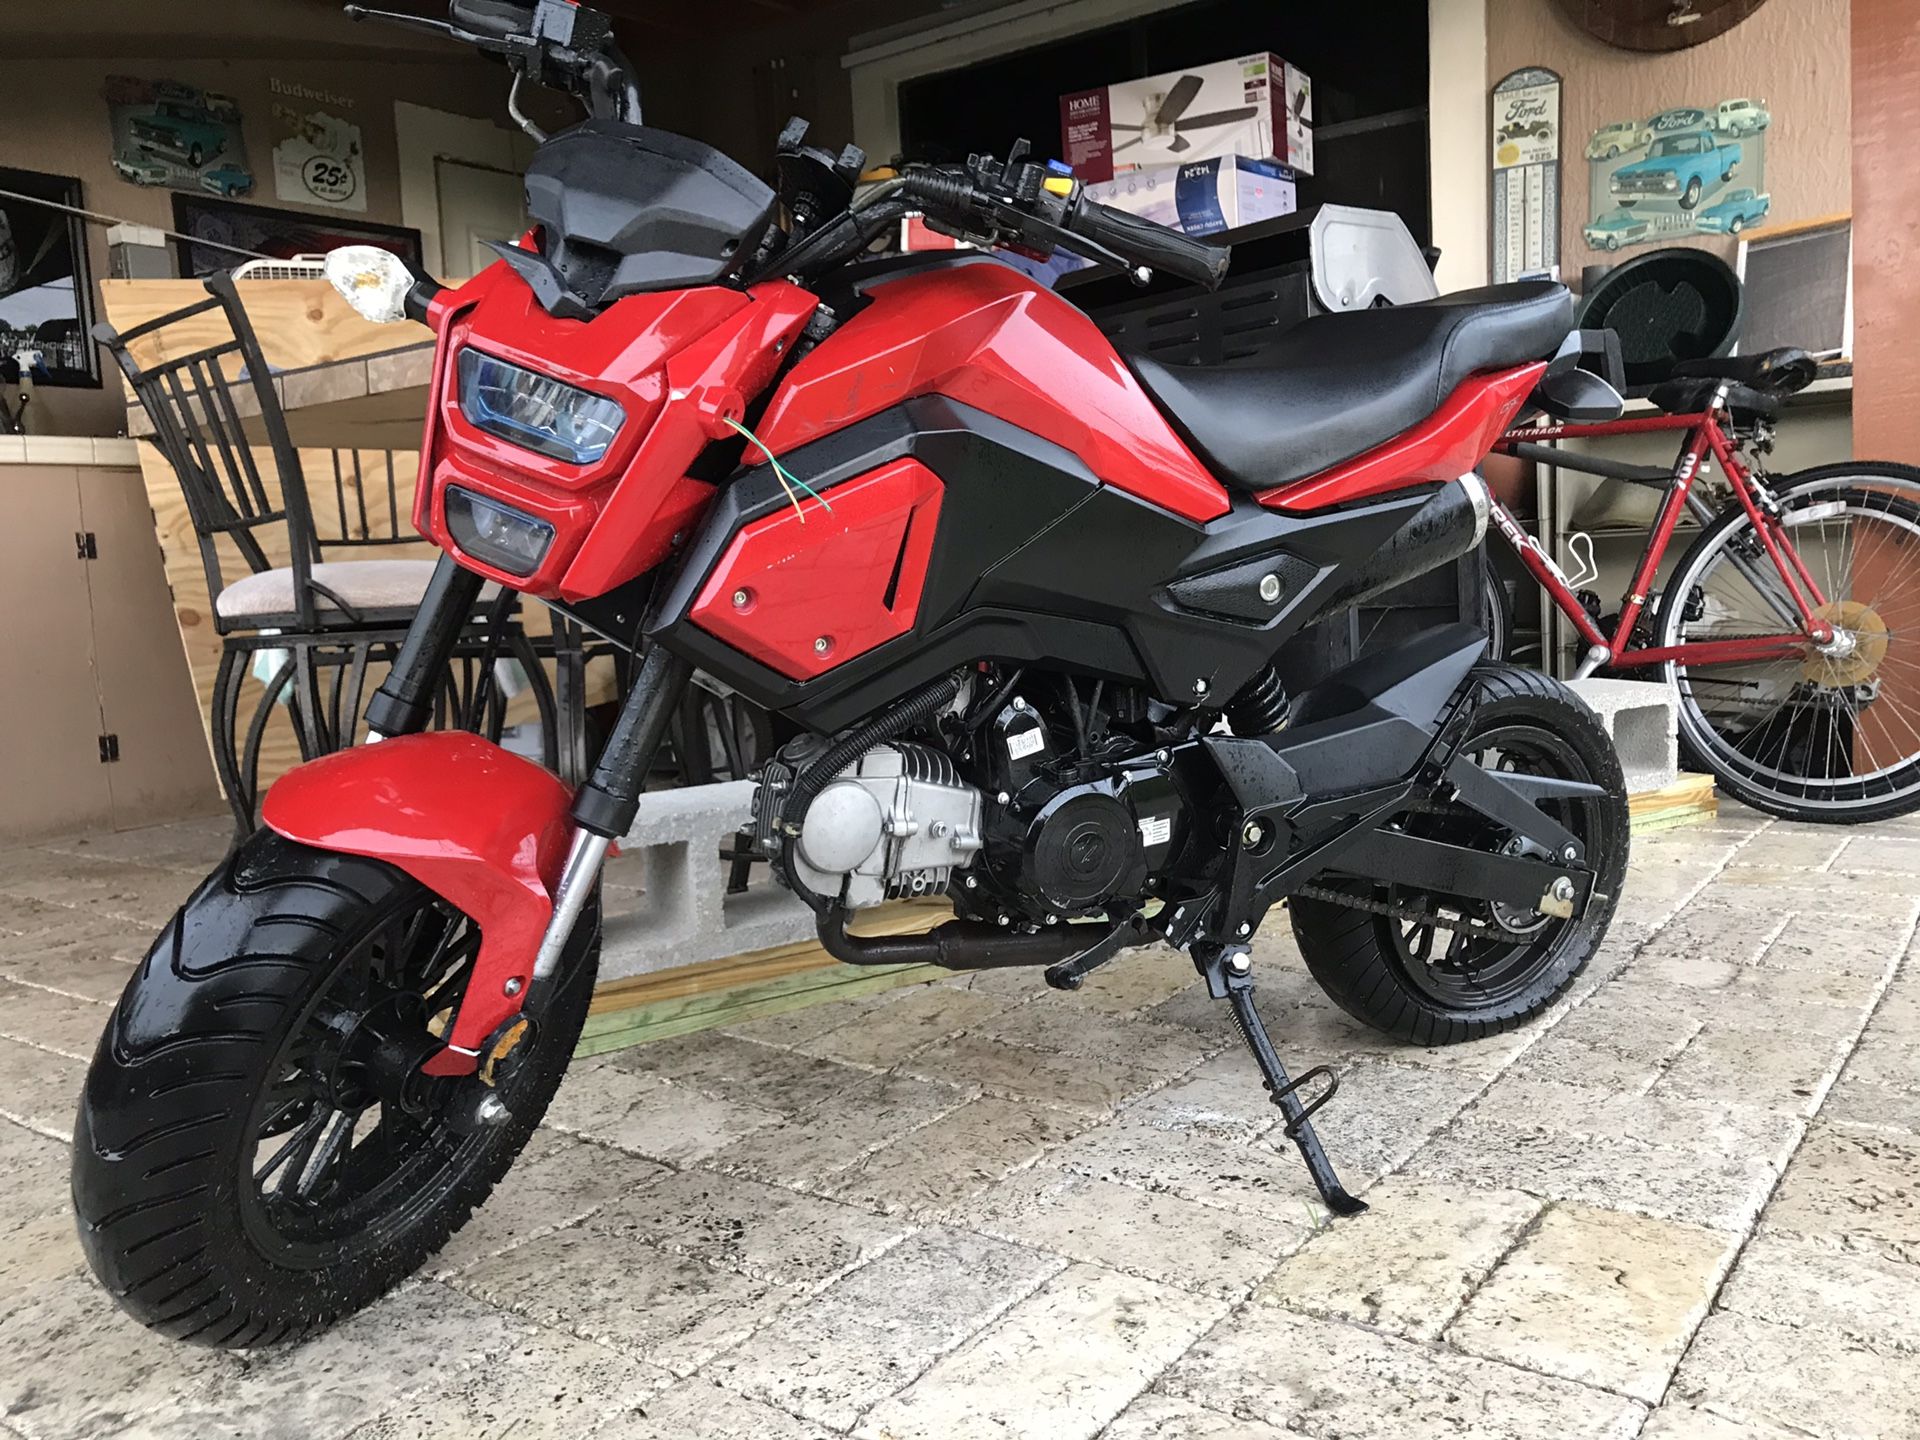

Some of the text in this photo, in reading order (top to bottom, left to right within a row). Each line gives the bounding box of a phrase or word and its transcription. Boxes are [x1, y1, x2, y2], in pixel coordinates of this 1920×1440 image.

[269, 77, 356, 109] Budweiser
[1069, 95, 1100, 111] HOME
[1505, 98, 1547, 121] Ford
[1657, 111, 1695, 130] Ford
[1489, 495, 1531, 554] REK
